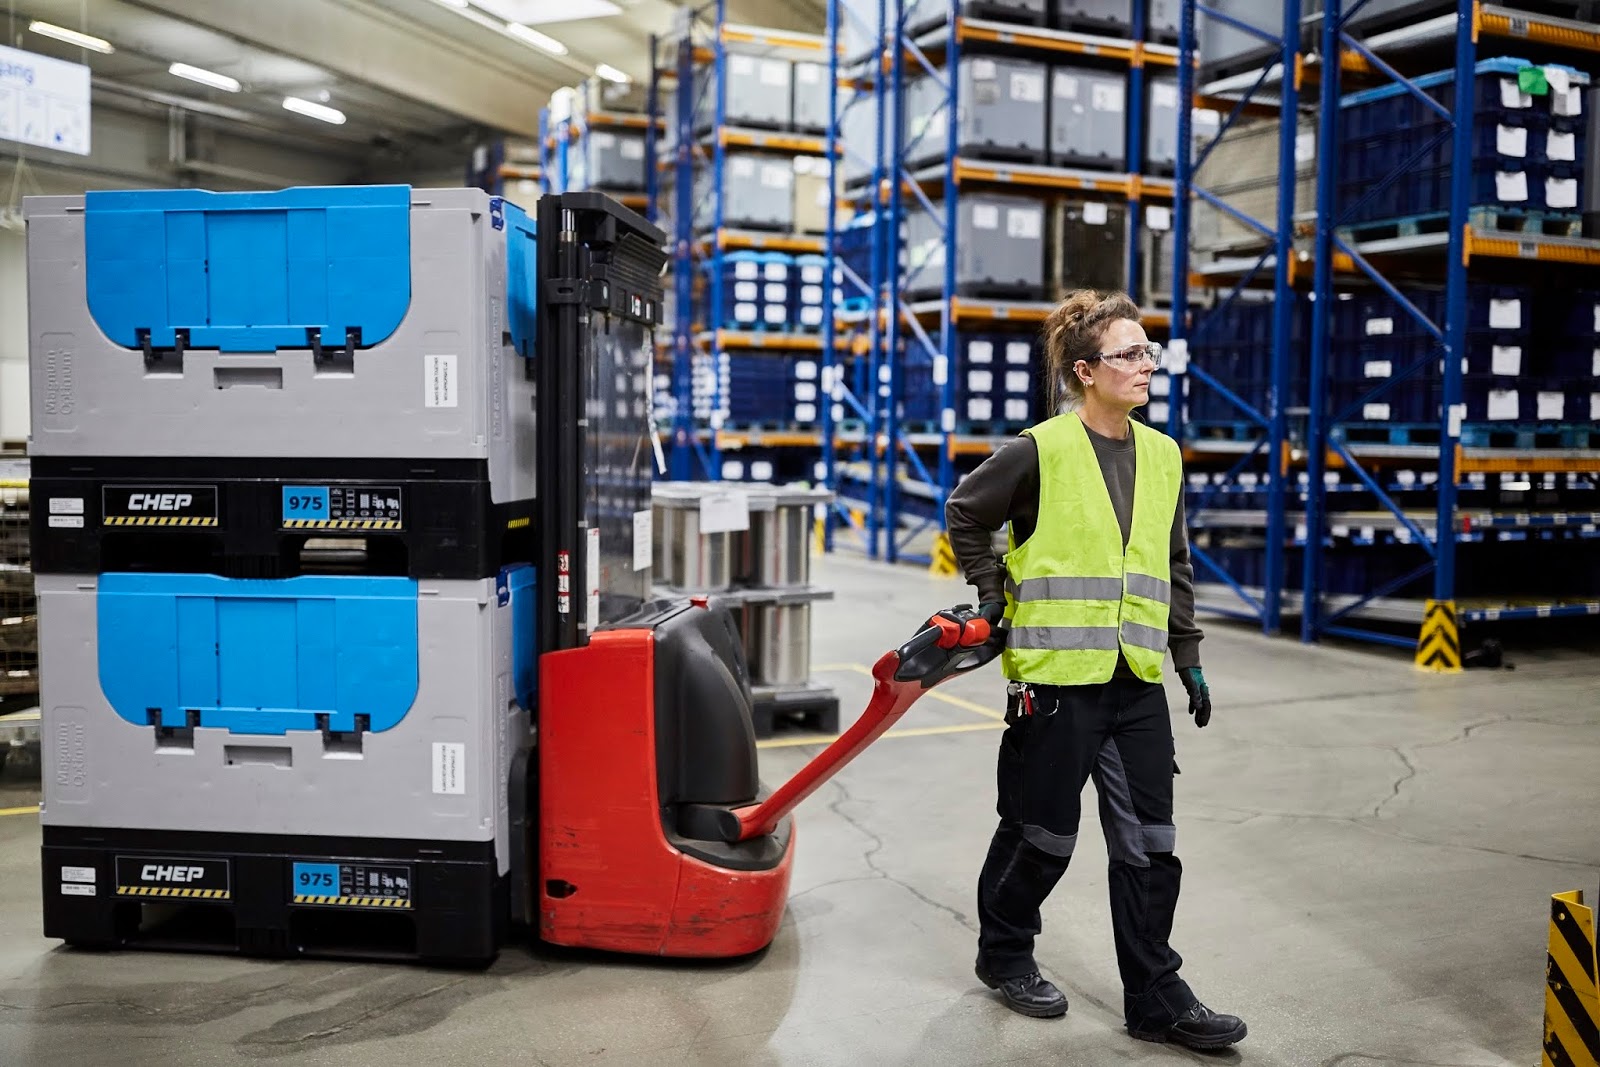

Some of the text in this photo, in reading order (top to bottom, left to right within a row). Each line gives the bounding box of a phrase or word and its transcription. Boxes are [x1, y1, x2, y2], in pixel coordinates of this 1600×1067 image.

[45, 350, 58, 415] Magnum
[60, 351, 75, 415] Optimum
[128, 493, 192, 511] CHEP
[289, 495, 323, 511] 975
[57, 723, 71, 786] Magnum
[141, 864, 205, 883] CHEP
[299, 872, 333, 887] 975
